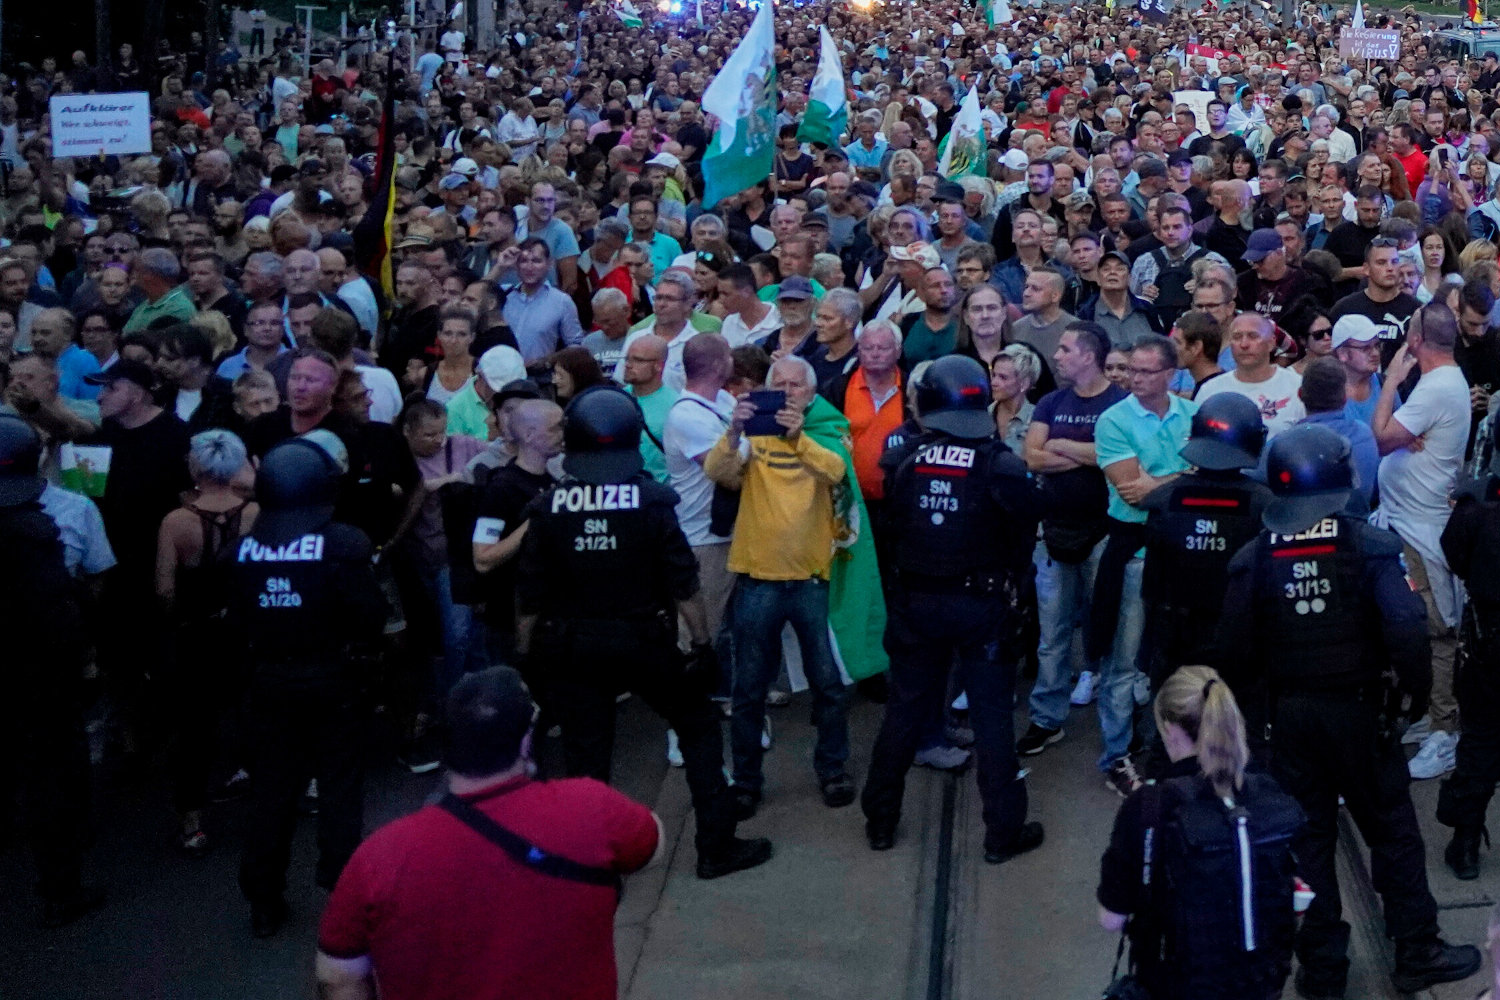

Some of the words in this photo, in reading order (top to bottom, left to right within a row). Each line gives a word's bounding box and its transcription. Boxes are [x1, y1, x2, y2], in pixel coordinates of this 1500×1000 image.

[929, 480, 951, 495] SN
[551, 484, 640, 514] POLIZEI
[919, 495, 959, 512] 31/13
[584, 519, 608, 534] SN
[1195, 518, 1218, 534] SN
[574, 534, 617, 552] 31/21
[1185, 534, 1227, 551] 31/13
[1292, 560, 1318, 579] SN
[266, 577, 291, 592] SN
[1284, 578, 1331, 599] 31/13
[258, 592, 302, 608] 31/20
